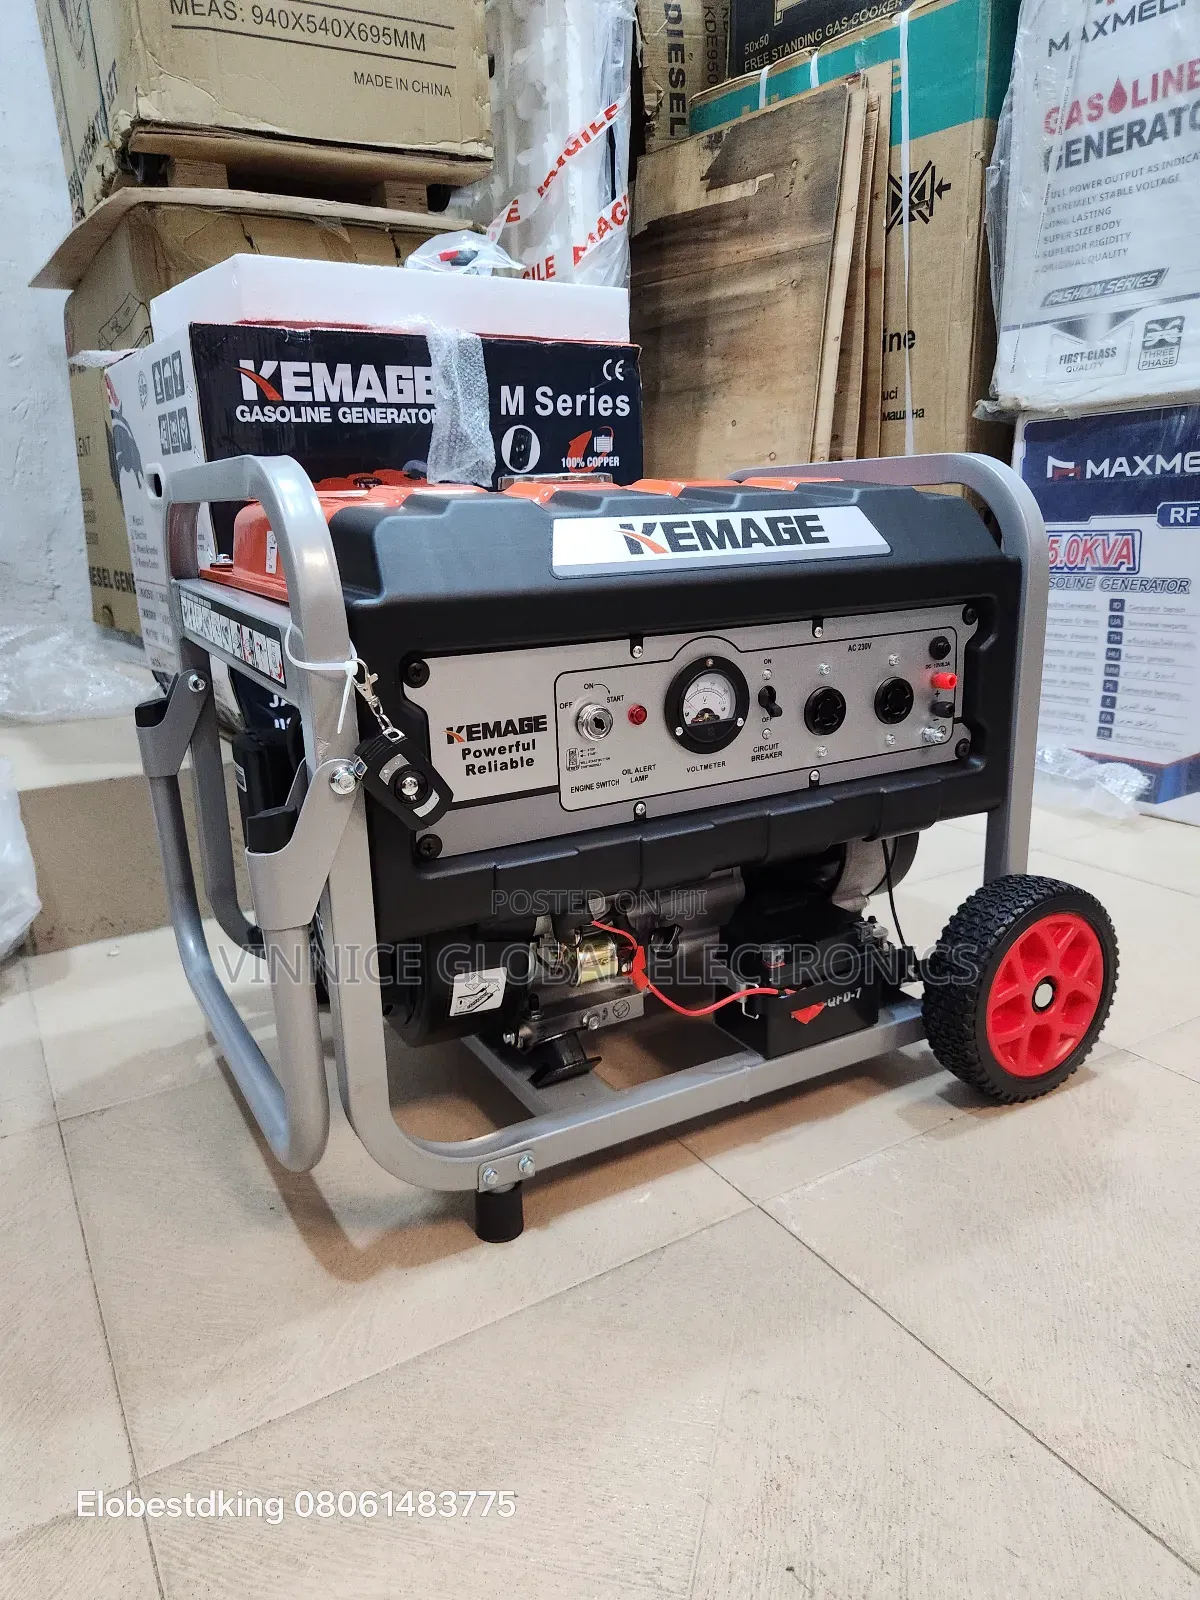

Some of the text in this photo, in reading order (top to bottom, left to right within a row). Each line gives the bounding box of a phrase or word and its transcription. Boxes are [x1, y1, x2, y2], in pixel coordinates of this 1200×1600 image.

[170, 0, 426, 52] MEAS: 940X540X695MM
[744, 33, 769, 55] 50x50
[744, 55, 770, 73] FREE
[772, 28, 823, 61] STANDING
[825, 19, 848, 37] GAS
[663, 2, 687, 137] DIESEL
[353, 71, 452, 98] MADE IN CHINA
[1069, 178, 1103, 192] POWER
[1105, 167, 1145, 185] OUTPUT
[1147, 163, 1160, 173] AS
[1100, 186, 1134, 202] STABLE
[1136, 173, 1181, 193] VOLTAGE
[1072, 206, 1112, 223] LASTING
[1043, 219, 1122, 244] SUPER SIZE BODY
[1042, 231, 1132, 259] SUPERIOR RIGIDITY
[1088, 247, 1129, 264] QUALITY
[1049, 270, 1159, 302] FASHION SERIES
[1058, 346, 1117, 366] FIRST-CLASS
[1143, 347, 1175, 357] THREE
[1065, 362, 1105, 373] QUALITY
[1141, 357, 1175, 369] PHASE
[234, 359, 436, 404] KEMAGE
[500, 385, 631, 417] M Series
[235, 405, 333, 424] GASOLINE
[882, 407, 925, 421] машна
[561, 456, 620, 468] 100% COPPER
[1169, 506, 1200, 524] RF
[612, 514, 830, 555] KEMAGE
[1099, 577, 1190, 594] GENERATOR
[858, 642, 872, 651] 230V
[559, 701, 573, 710] OFF
[607, 695, 625, 703] START
[443, 714, 548, 745] KEMAGE
[461, 739, 537, 761] Powerful
[751, 751, 783, 762] BREAKER
[753, 743, 779, 753] CIRCUIT
[465, 756, 535, 777] Reliable
[622, 764, 657, 775] OIL ALERT
[686, 761, 727, 774] VOLTMETER
[570, 779, 620, 794] ENGINE SWITCH
[630, 774, 649, 784] LAMP
